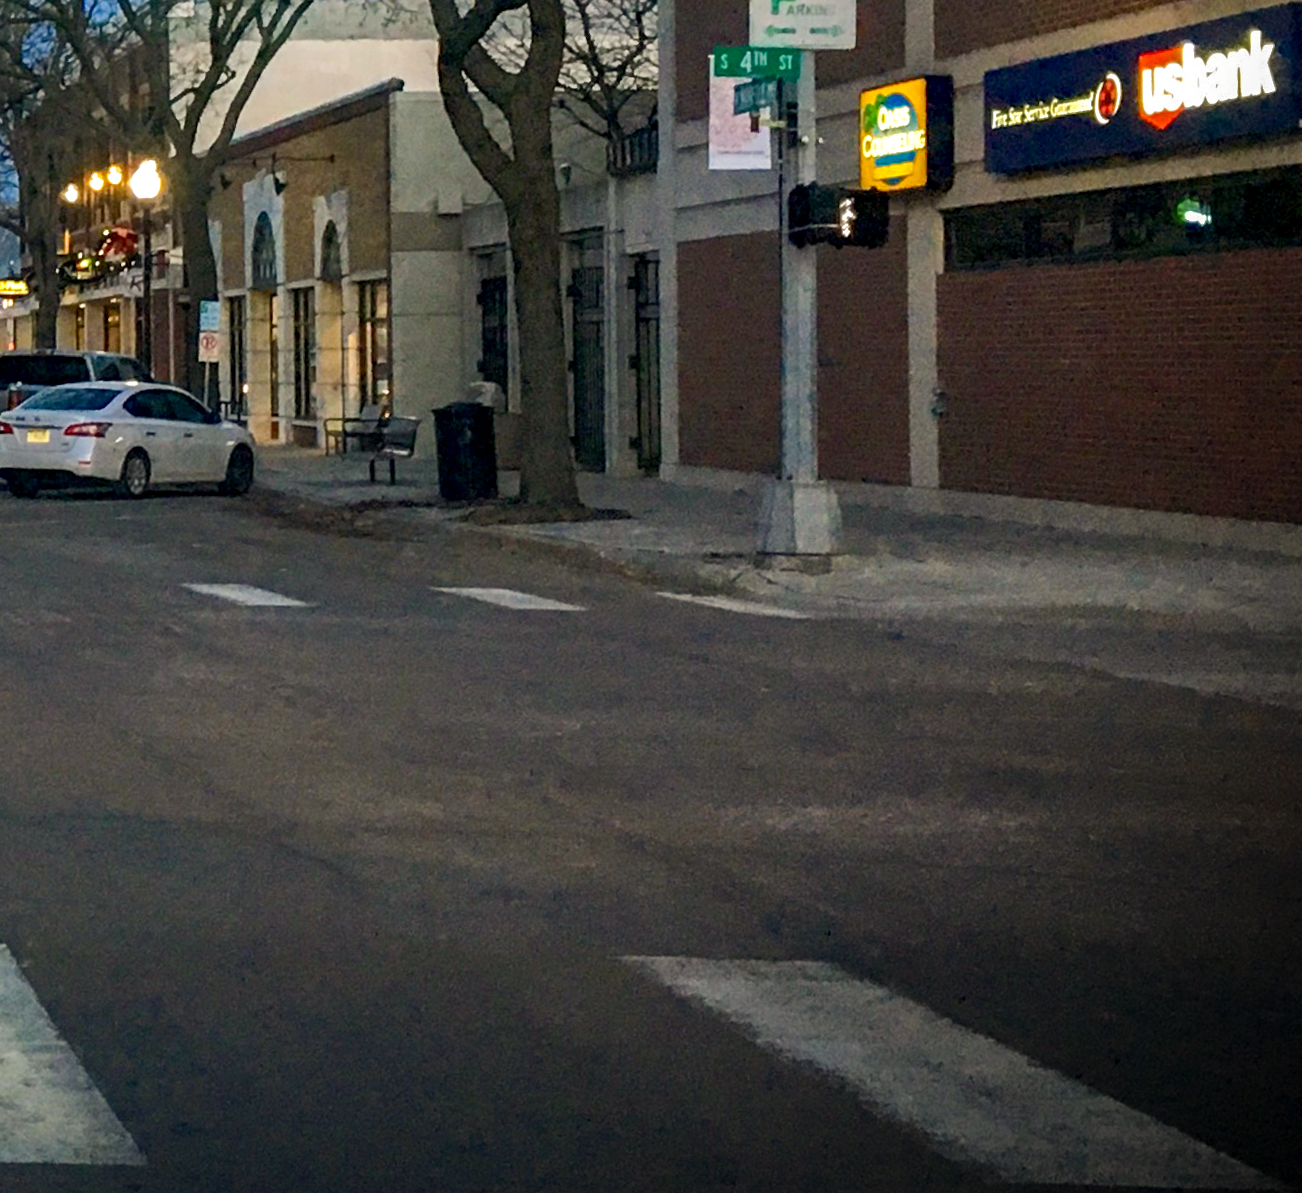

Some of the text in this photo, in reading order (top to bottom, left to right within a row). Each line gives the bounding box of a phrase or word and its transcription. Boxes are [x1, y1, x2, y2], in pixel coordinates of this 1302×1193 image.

[720, 51, 793, 73] S 4TH ST
